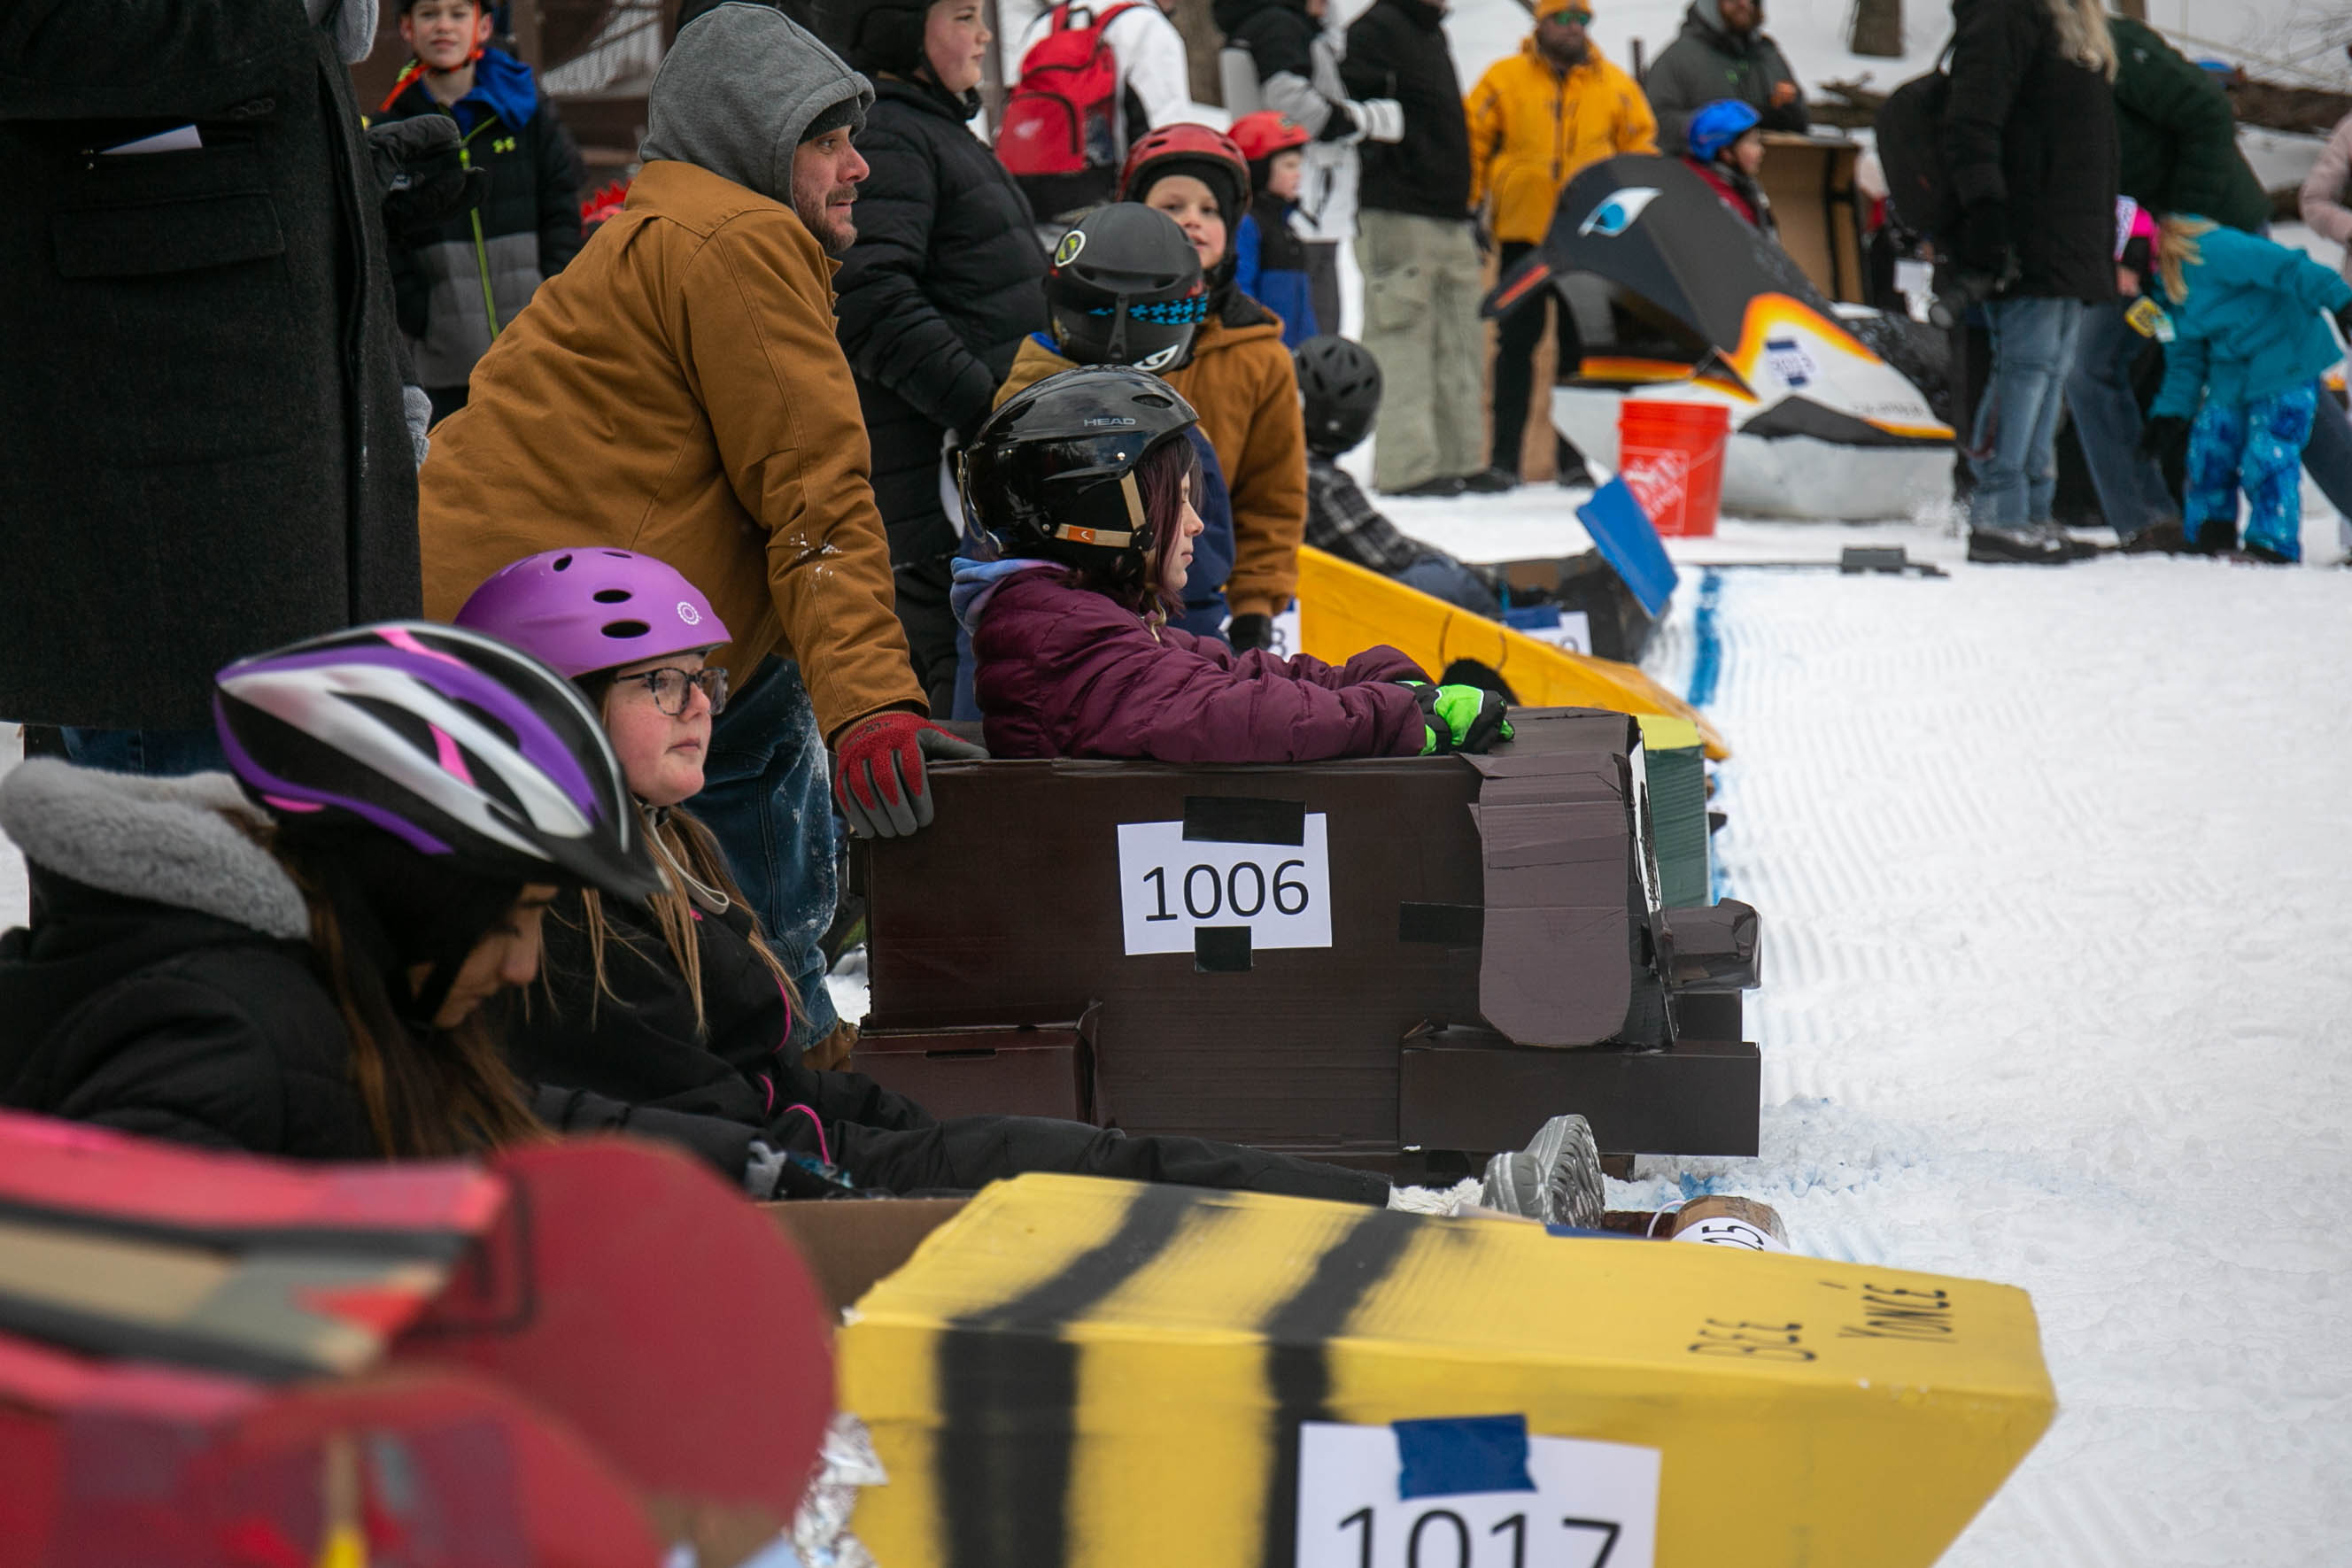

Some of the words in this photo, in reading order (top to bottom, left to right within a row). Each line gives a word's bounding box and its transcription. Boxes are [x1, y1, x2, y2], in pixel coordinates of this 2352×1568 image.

[1083, 417, 1136, 427] HEAD
[1143, 859, 1309, 922] 1006
[1687, 1317, 1817, 1362] BEE
[1338, 1506, 1621, 1568] 1017
